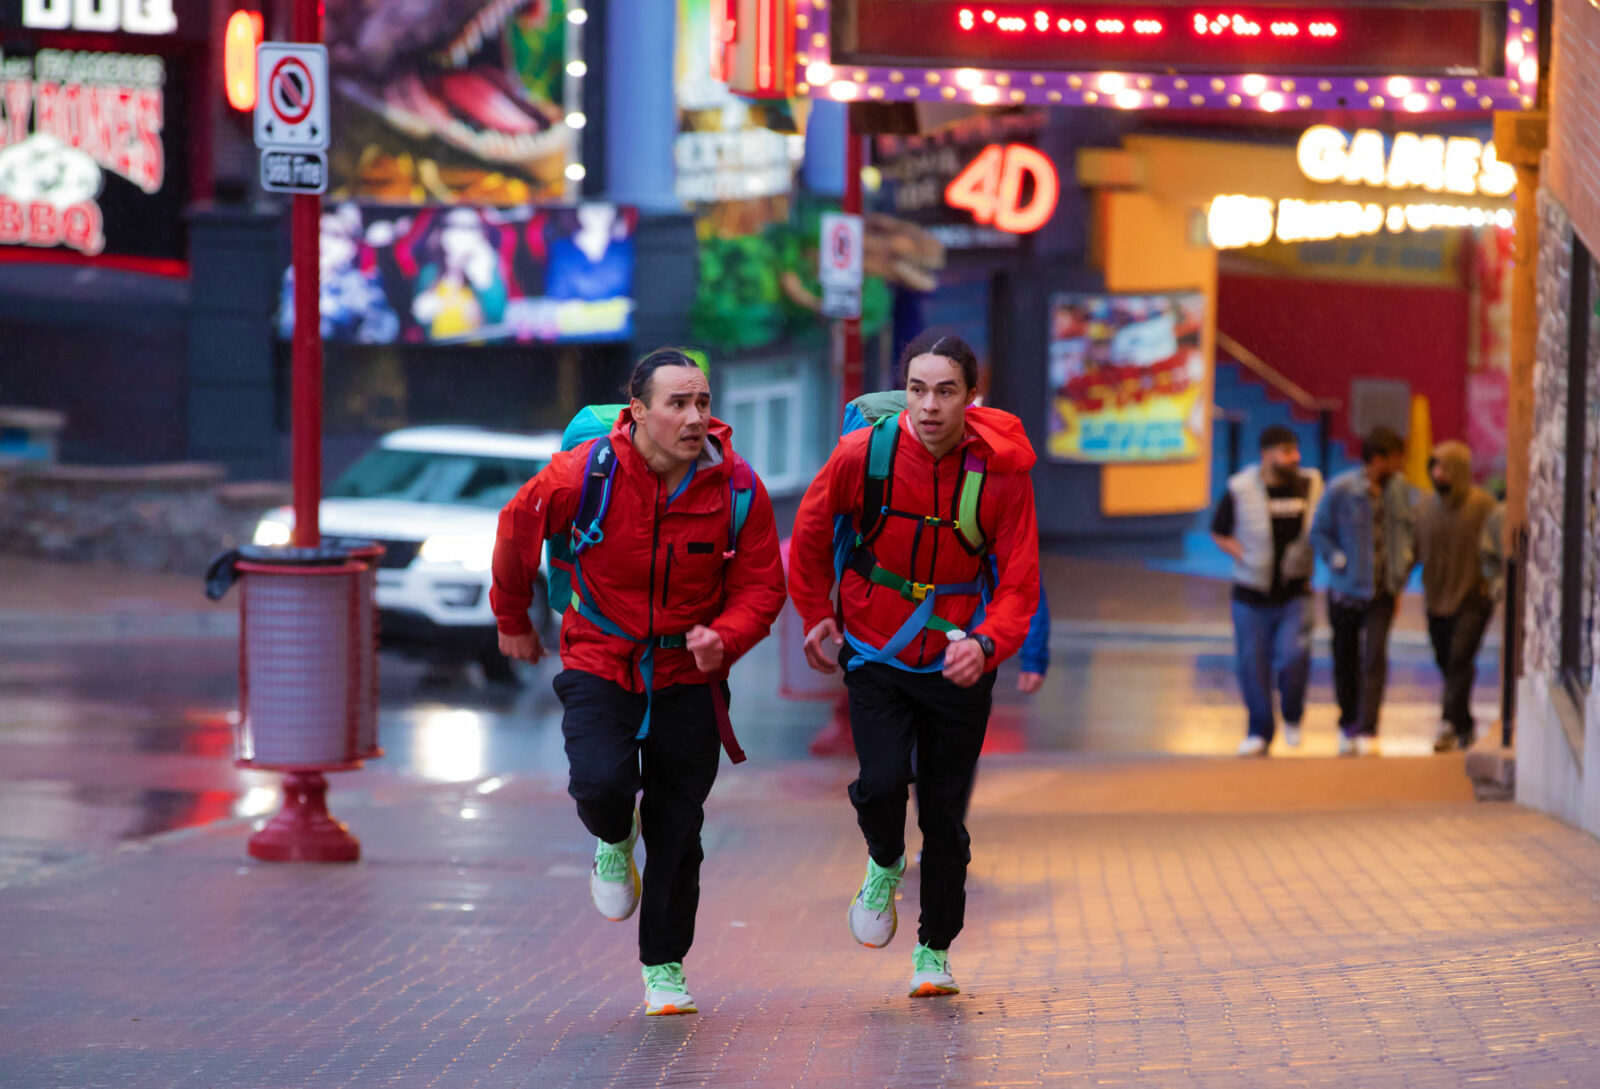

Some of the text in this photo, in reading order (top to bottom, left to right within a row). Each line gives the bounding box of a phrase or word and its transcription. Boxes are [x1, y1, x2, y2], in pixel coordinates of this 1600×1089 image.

[945, 143, 1060, 234] 4D
[1297, 124, 1518, 197] GAMES
[0, 198, 106, 256] BBQ
